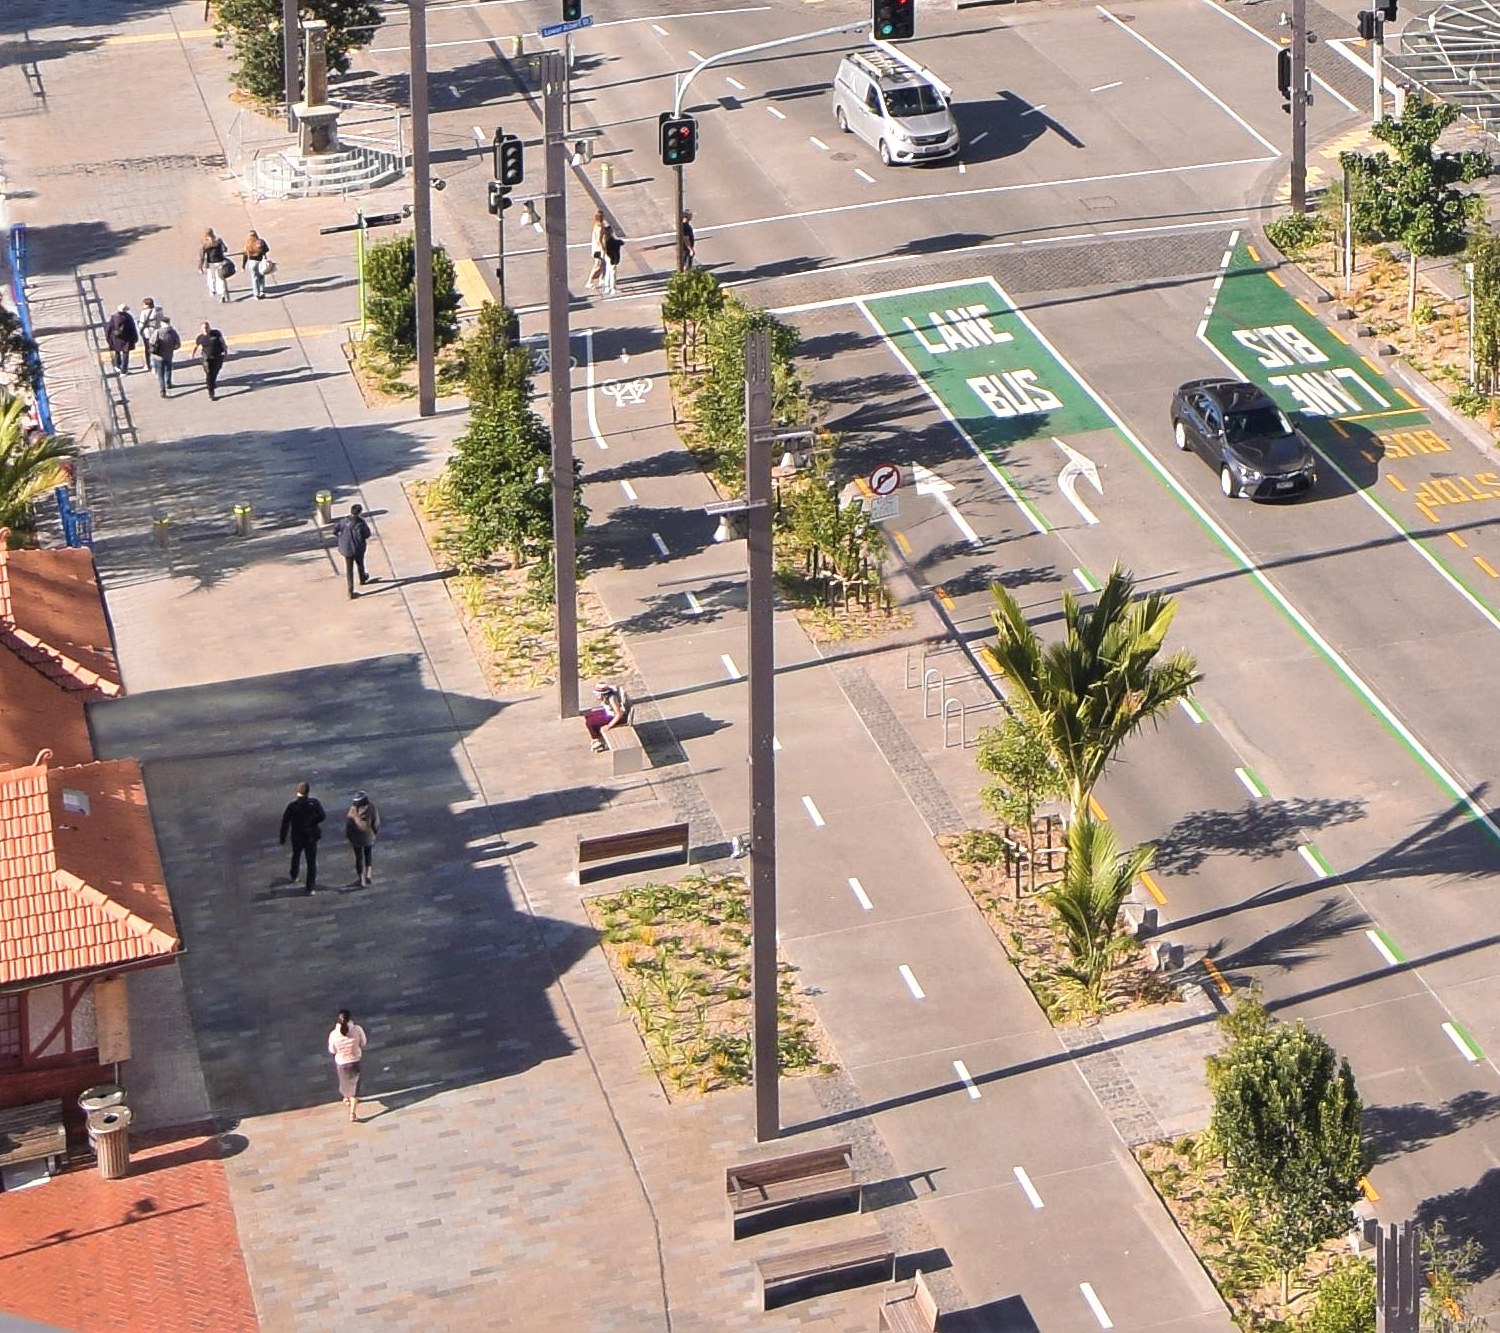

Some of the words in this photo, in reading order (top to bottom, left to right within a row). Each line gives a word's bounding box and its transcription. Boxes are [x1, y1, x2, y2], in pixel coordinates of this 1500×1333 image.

[902, 304, 1014, 354] LANE
[1232, 324, 1330, 368] BUS
[966, 368, 1064, 418] BUS
[1268, 368, 1391, 416] LANE
